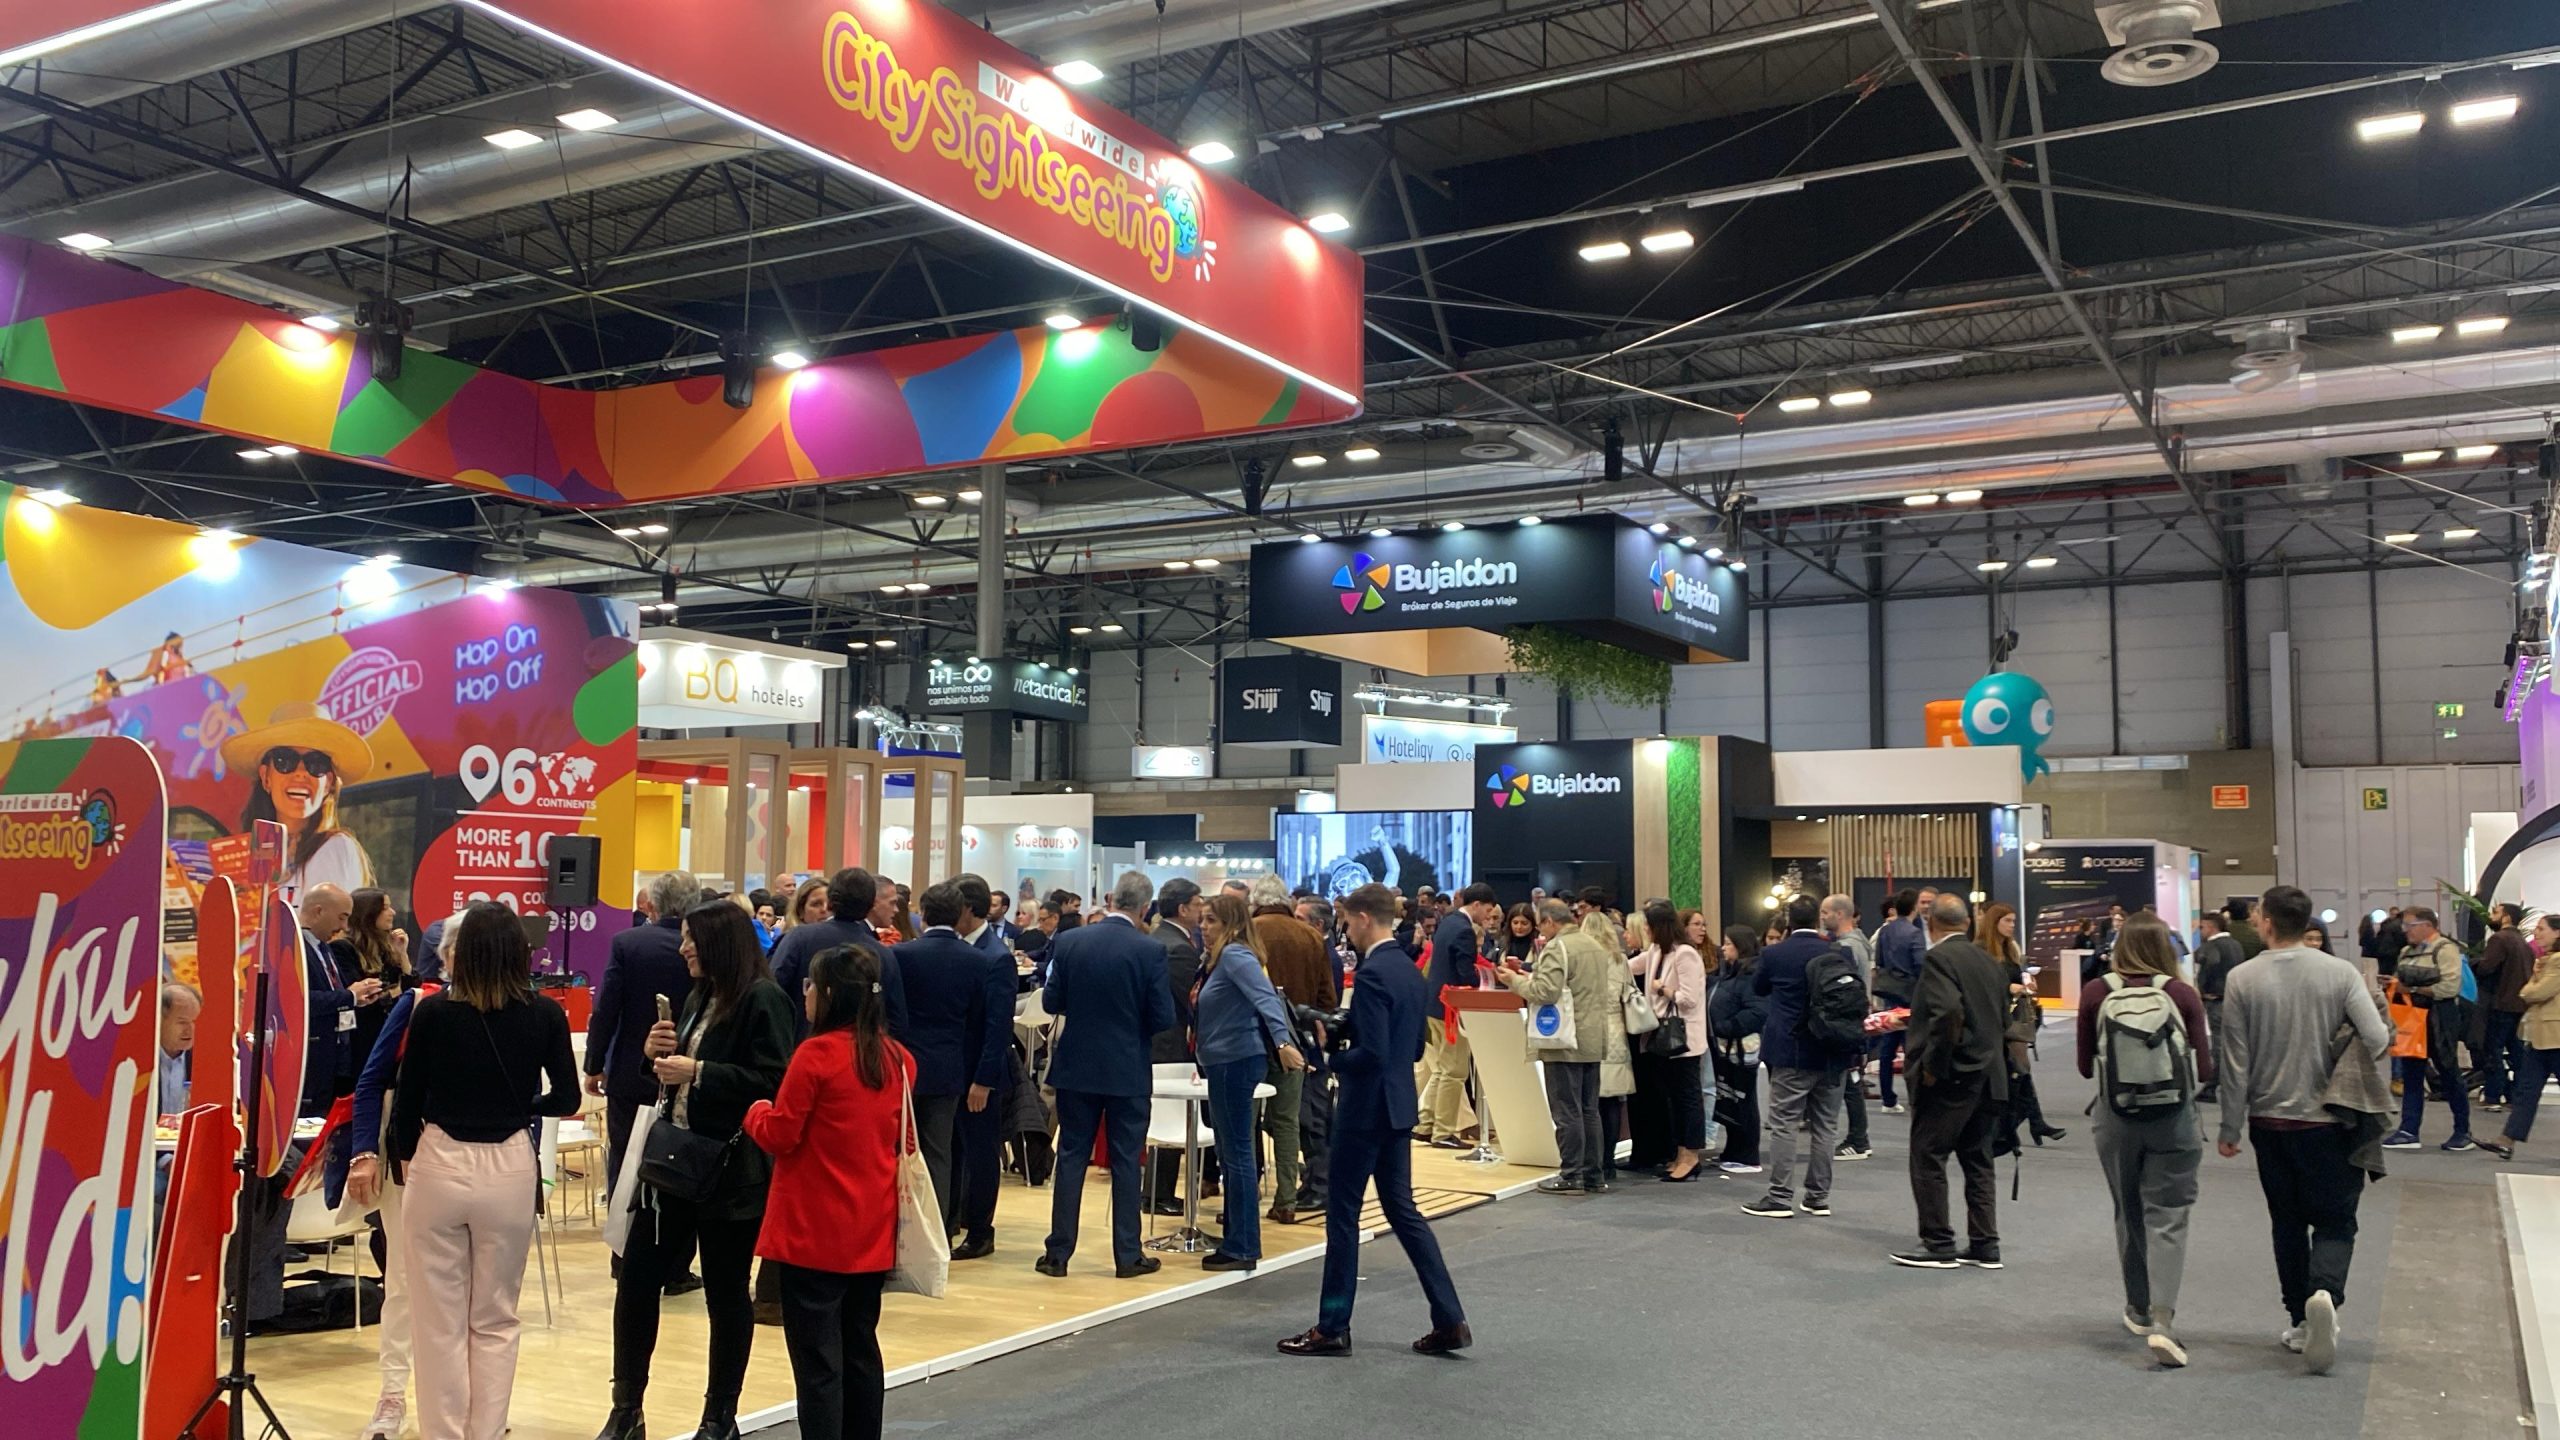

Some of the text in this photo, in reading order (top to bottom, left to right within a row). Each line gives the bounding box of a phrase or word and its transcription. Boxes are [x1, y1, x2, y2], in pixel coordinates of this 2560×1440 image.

[1395, 557, 1517, 595] Bujaldon
[1401, 596, 1518, 612] Bróker de Seguros de Viaje
[506, 654, 543, 689] Off
[686, 657, 805, 708] BQ hoteles
[973, 684, 992, 694] para
[331, 666, 414, 720] FFICIAL
[928, 694, 990, 706] cambiarlo todo
[349, 706, 386, 732] OUR
[1532, 772, 1621, 798] Bujaldon
[0, 796, 69, 812] rldwide
[537, 797, 597, 810] CONTINENTS
[456, 827, 512, 847] MORE
[456, 850, 510, 868] THAN
[2024, 858, 2066, 868] CTORATE
[2092, 858, 2145, 868] OCTORATE
